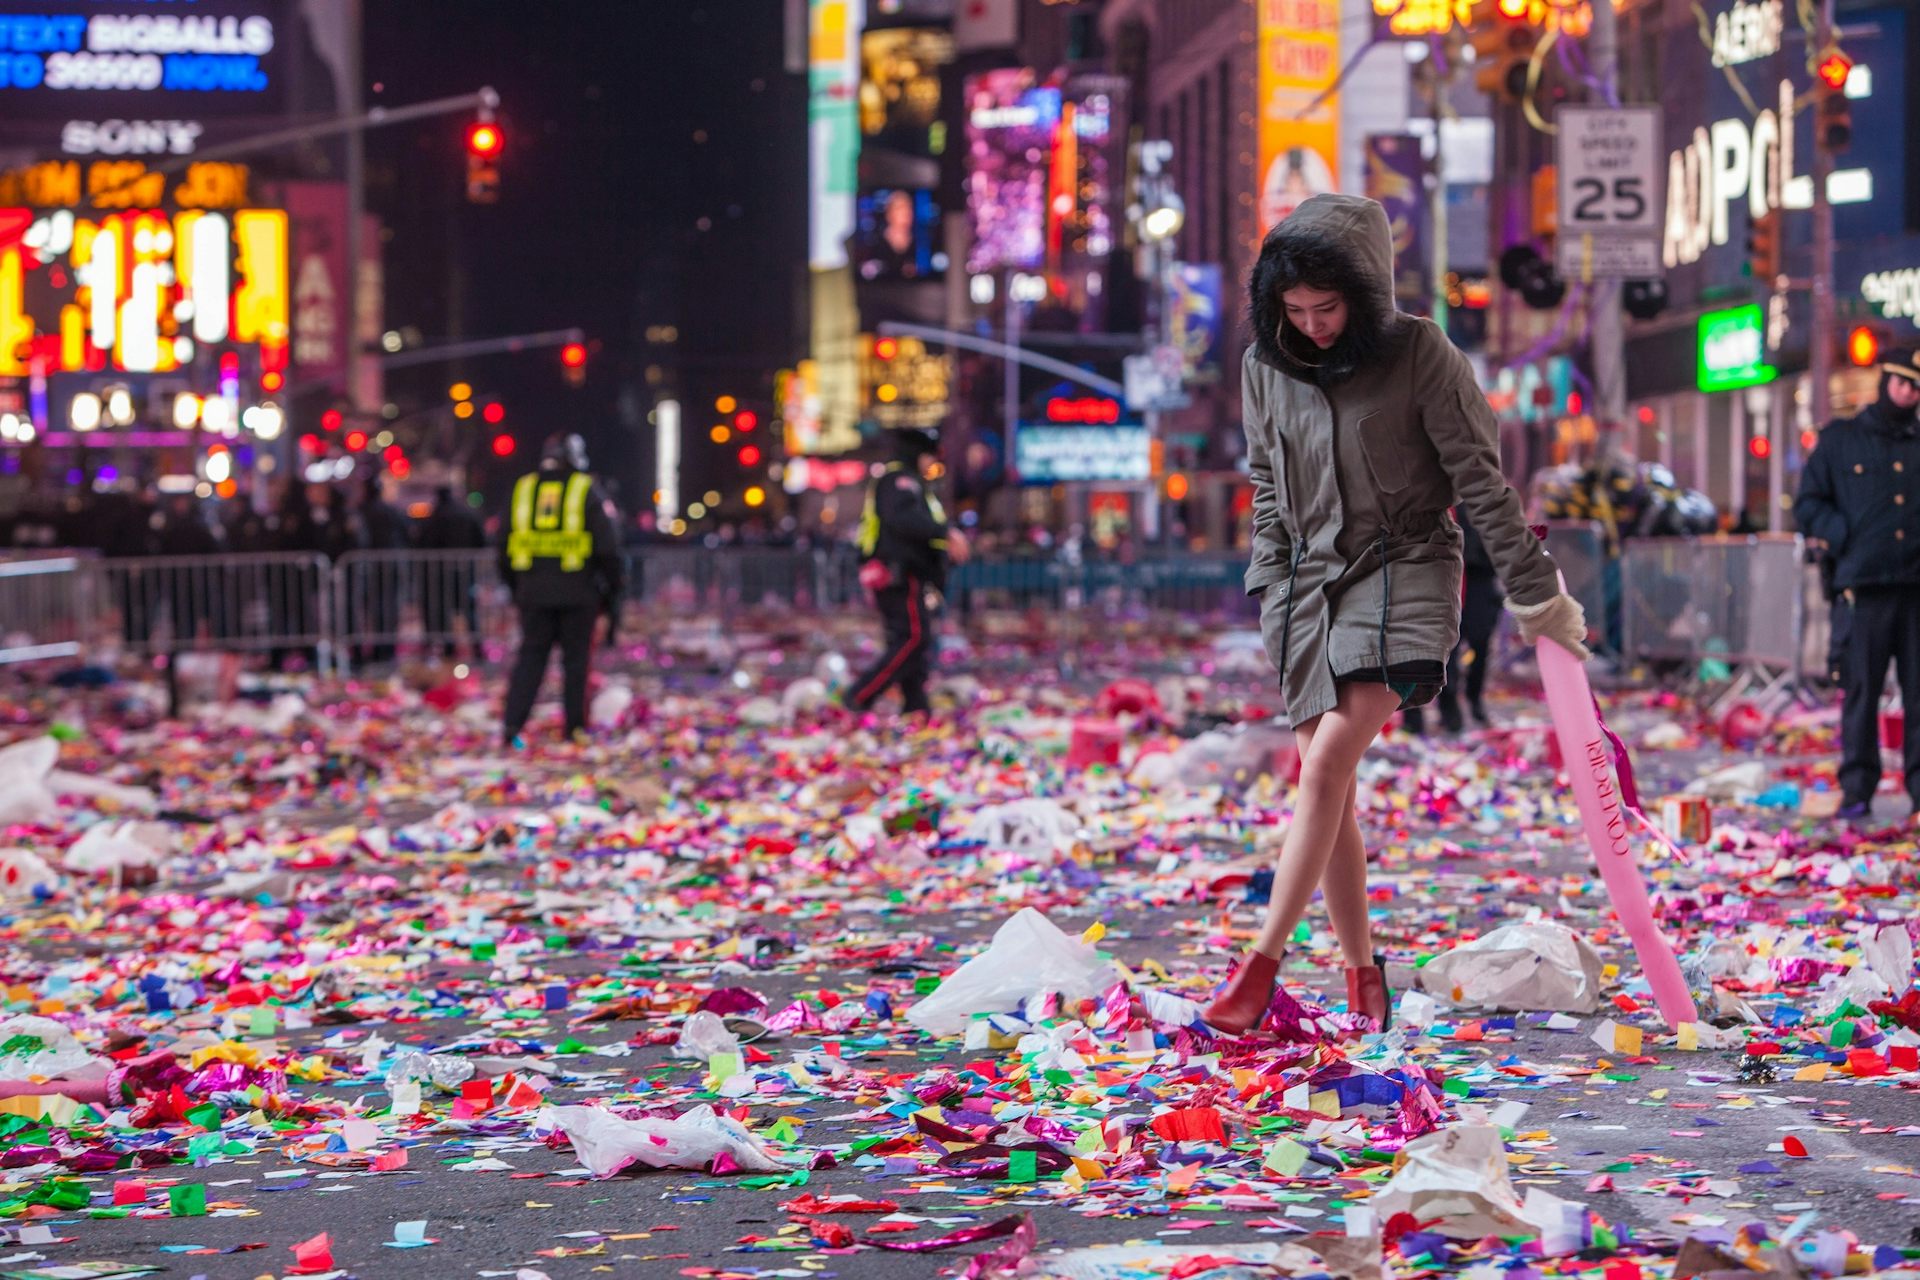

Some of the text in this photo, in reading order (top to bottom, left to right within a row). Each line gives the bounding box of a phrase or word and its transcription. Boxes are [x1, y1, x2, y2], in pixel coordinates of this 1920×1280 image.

[87, 14, 274, 56] BIGBALLS
[61, 119, 203, 154] SONY
[1581, 137, 1637, 151] SPEED
[1584, 157, 1632, 171] LIMIT
[1573, 177, 1646, 222] 25
[1585, 740, 1630, 857] COVERGIRL
